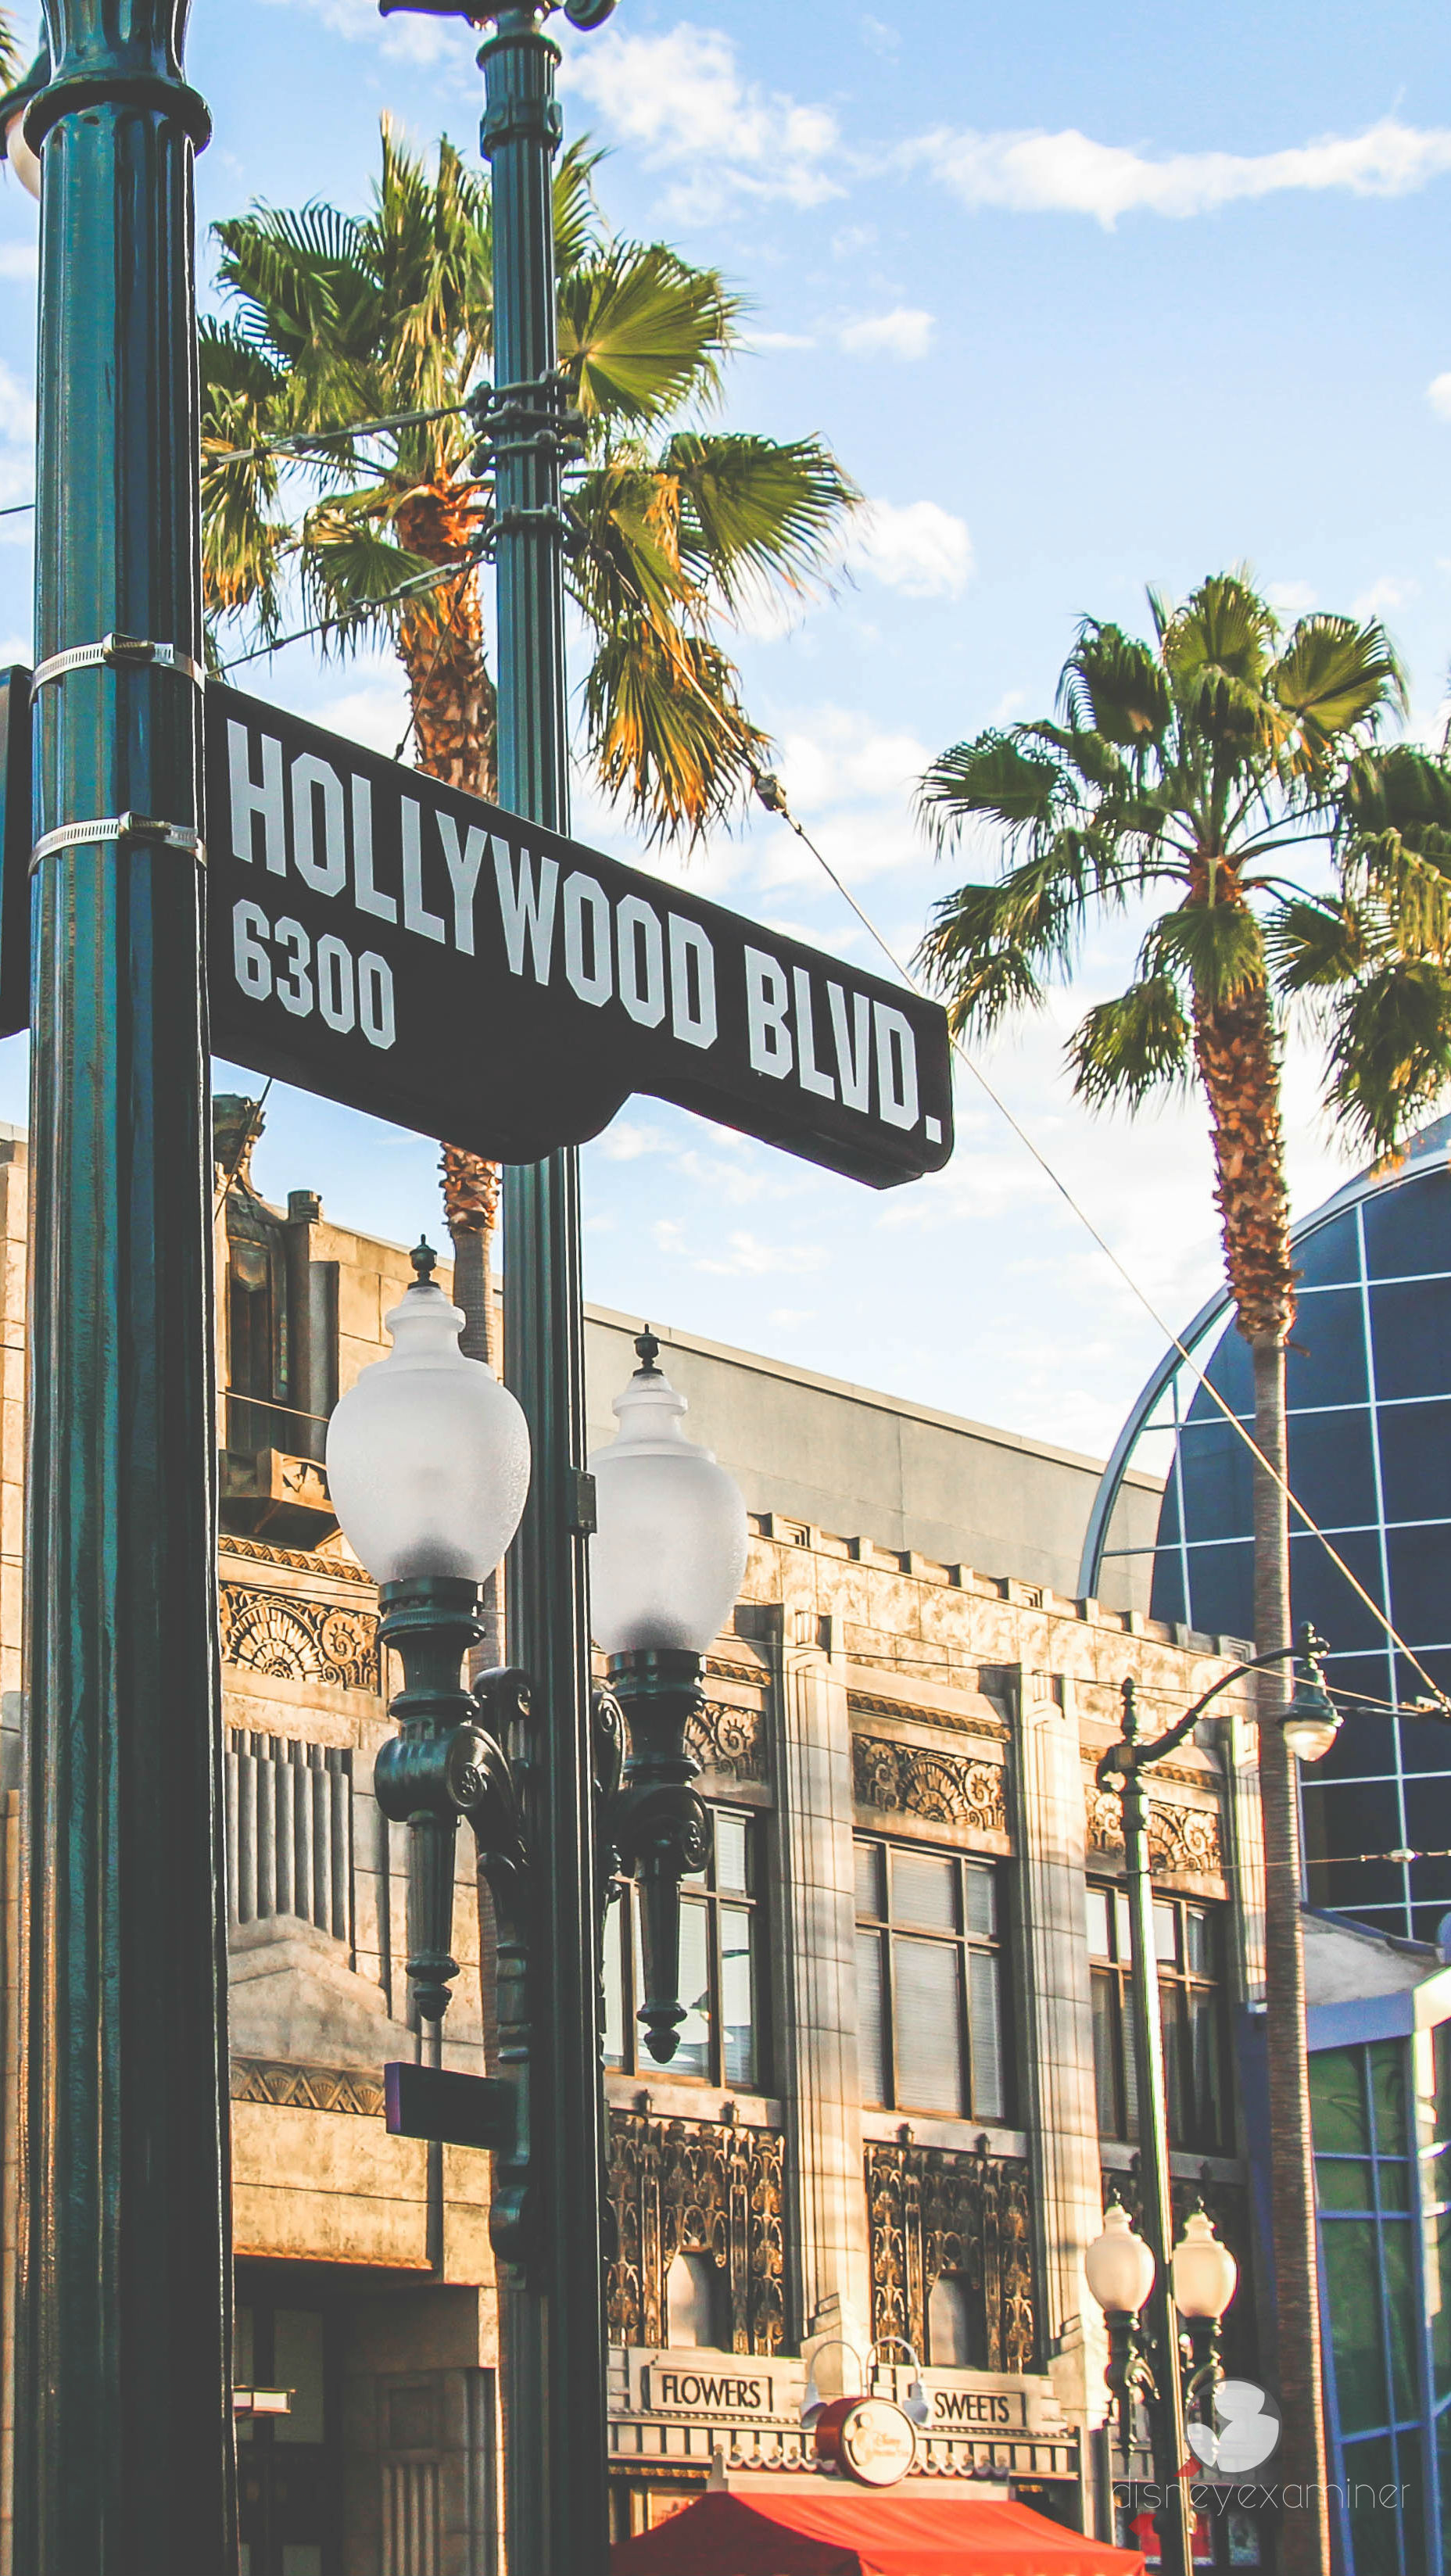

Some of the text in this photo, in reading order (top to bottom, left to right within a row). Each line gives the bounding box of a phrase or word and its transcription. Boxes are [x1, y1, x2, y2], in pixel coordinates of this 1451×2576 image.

[227, 718, 941, 1144] HOLLYWOOD BLVD.
[233, 899, 396, 1049] 6300
[662, 2374, 761, 2409] FLOWERS
[935, 2392, 1009, 2423] SWEETS
